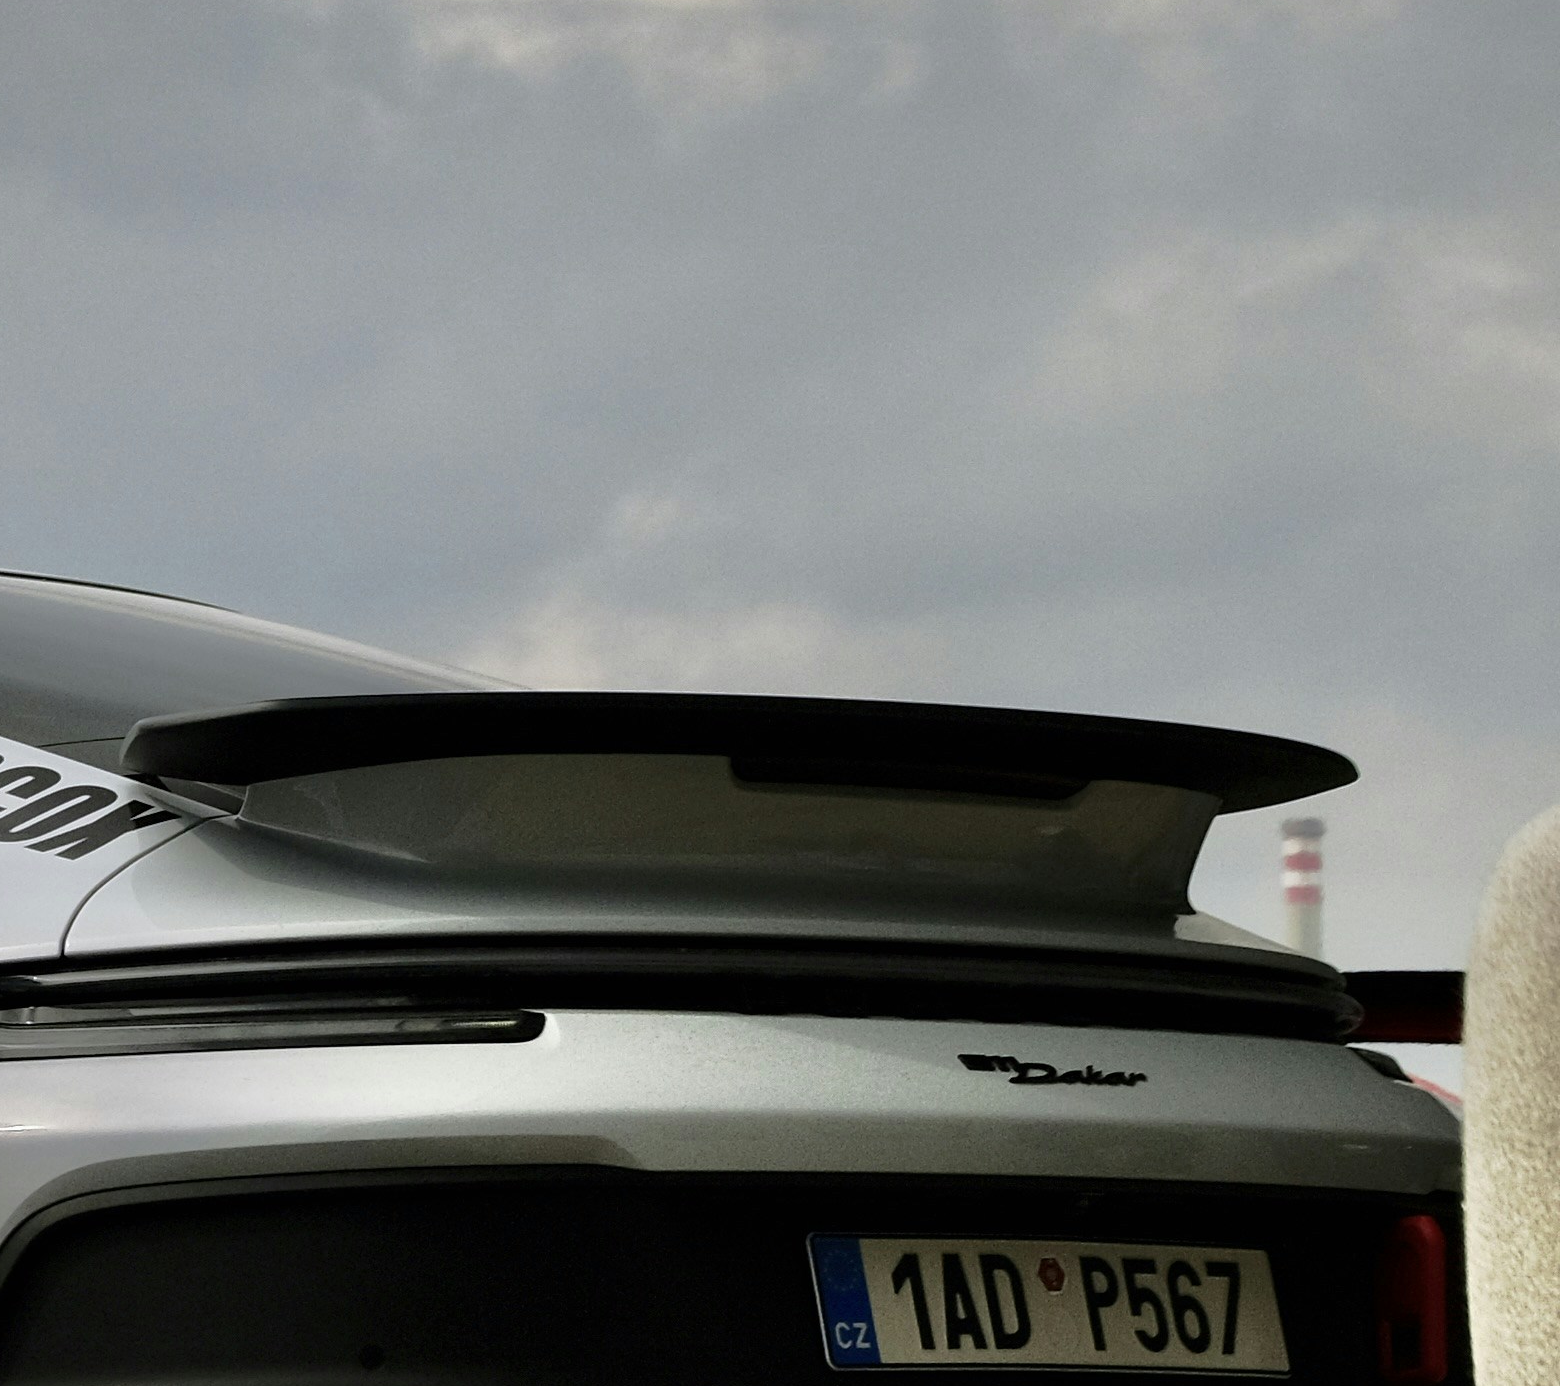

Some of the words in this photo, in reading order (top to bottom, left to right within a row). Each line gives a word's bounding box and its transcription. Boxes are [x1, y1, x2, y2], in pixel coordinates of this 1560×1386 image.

[1009, 1062, 1148, 1086] Dakar
[891, 1251, 1033, 1352] 1AD
[1079, 1254, 1243, 1357] P567
[834, 1321, 872, 1350] CZ
